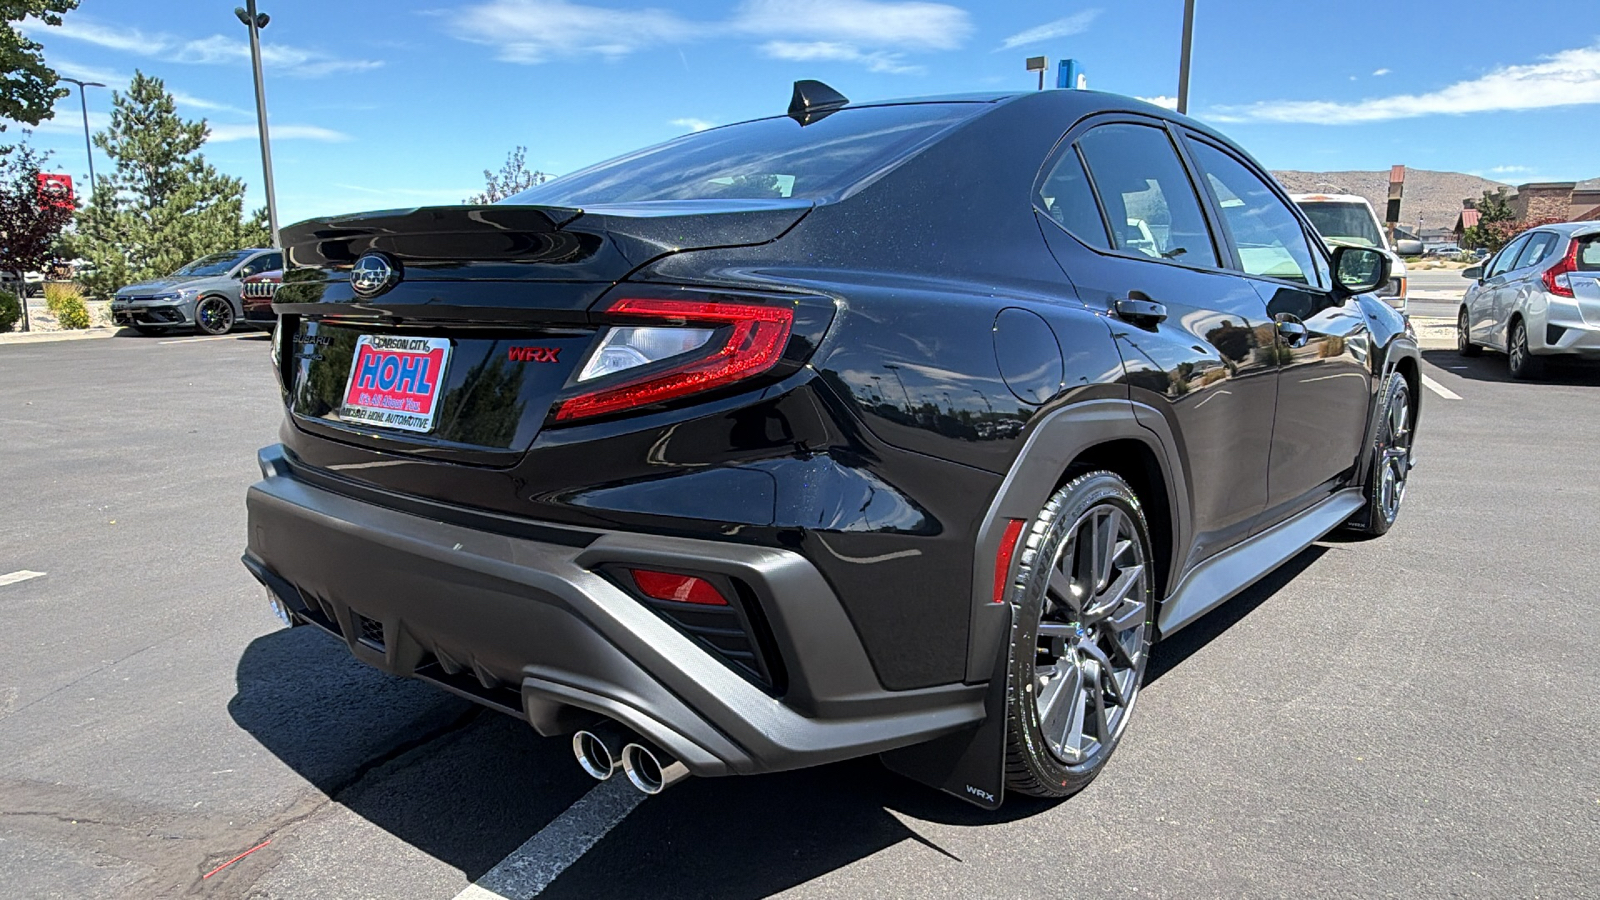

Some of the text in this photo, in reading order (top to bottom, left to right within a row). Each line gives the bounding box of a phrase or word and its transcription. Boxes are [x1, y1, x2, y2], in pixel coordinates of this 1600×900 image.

[292, 334, 331, 346] SUBARU
[378, 338, 429, 351] CARSON CITY
[508, 346, 561, 363] WRX
[357, 354, 432, 394] HOHL
[372, 394, 381, 406] All
[382, 395, 405, 409] About
[385, 413, 429, 428] AUTOMOTIVE
[966, 784, 994, 802] WRX
